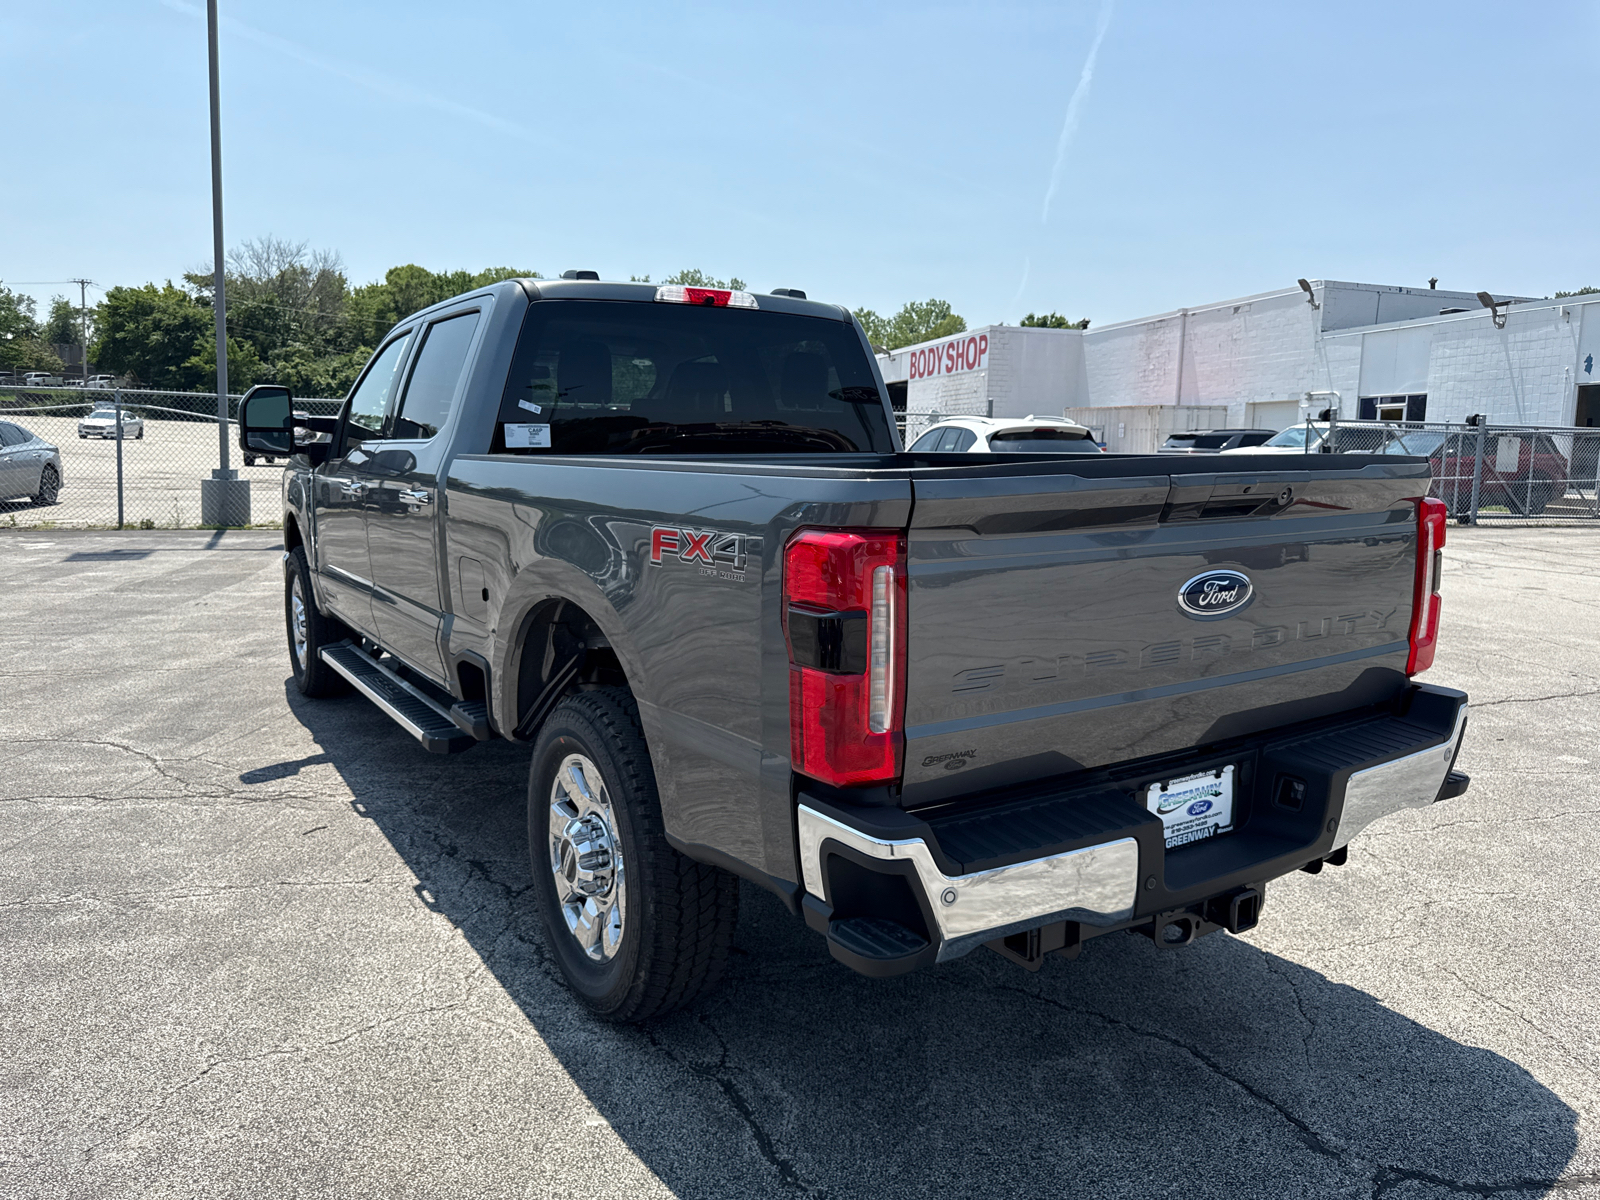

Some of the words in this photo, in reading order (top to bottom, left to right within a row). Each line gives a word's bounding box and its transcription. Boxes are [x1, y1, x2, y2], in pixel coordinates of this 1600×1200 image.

[649, 523, 748, 573] FX4
[699, 567, 717, 577] OFF
[719, 570, 746, 583] ROAD
[1199, 580, 1239, 606] Ford
[951, 634, 1232, 697] SUPER
[1251, 607, 1398, 650] DUTY
[1159, 781, 1222, 808] GREENWAY
[1165, 826, 1216, 849] GREENWAY
